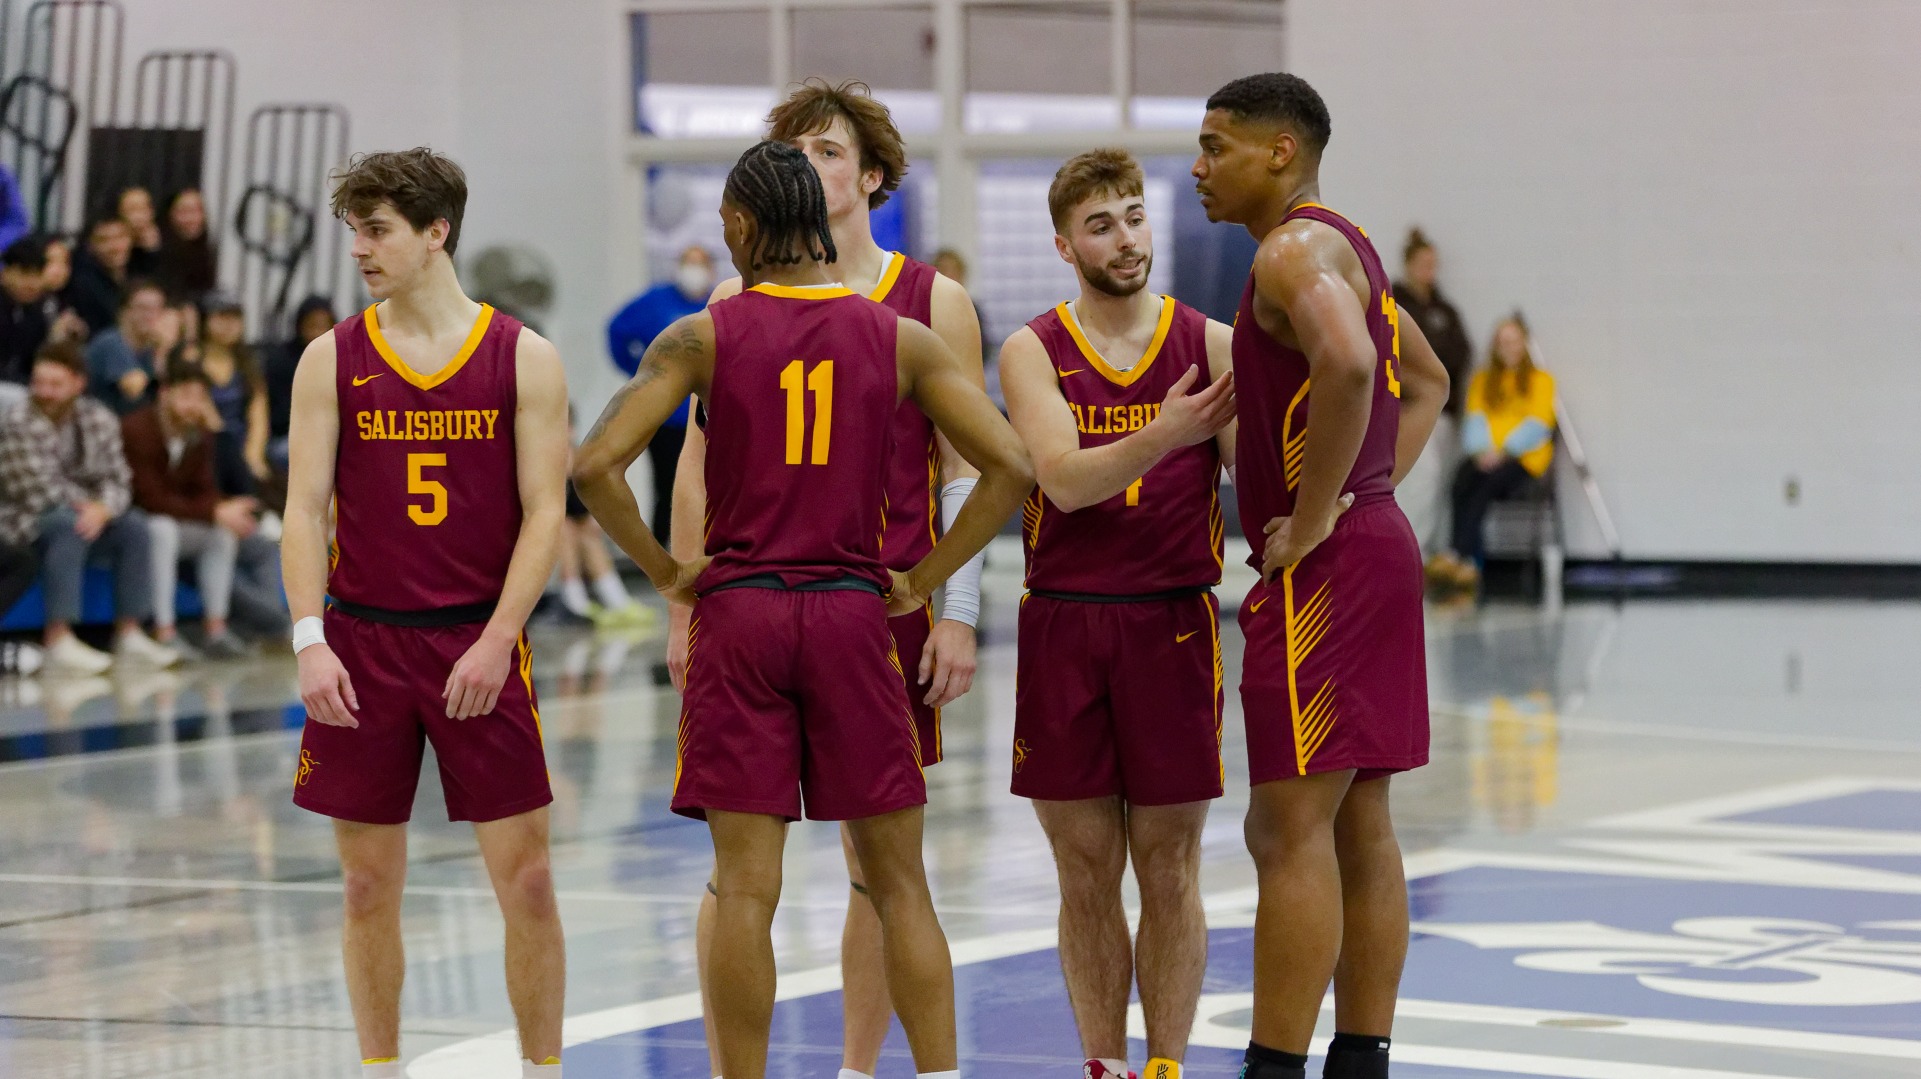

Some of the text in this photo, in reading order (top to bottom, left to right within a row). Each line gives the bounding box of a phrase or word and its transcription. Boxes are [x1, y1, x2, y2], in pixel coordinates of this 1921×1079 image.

[356, 409, 499, 441] SALISBURY
[780, 359, 834, 465] 11
[1069, 402, 1161, 434] ALISBU
[407, 453, 448, 526] 5
